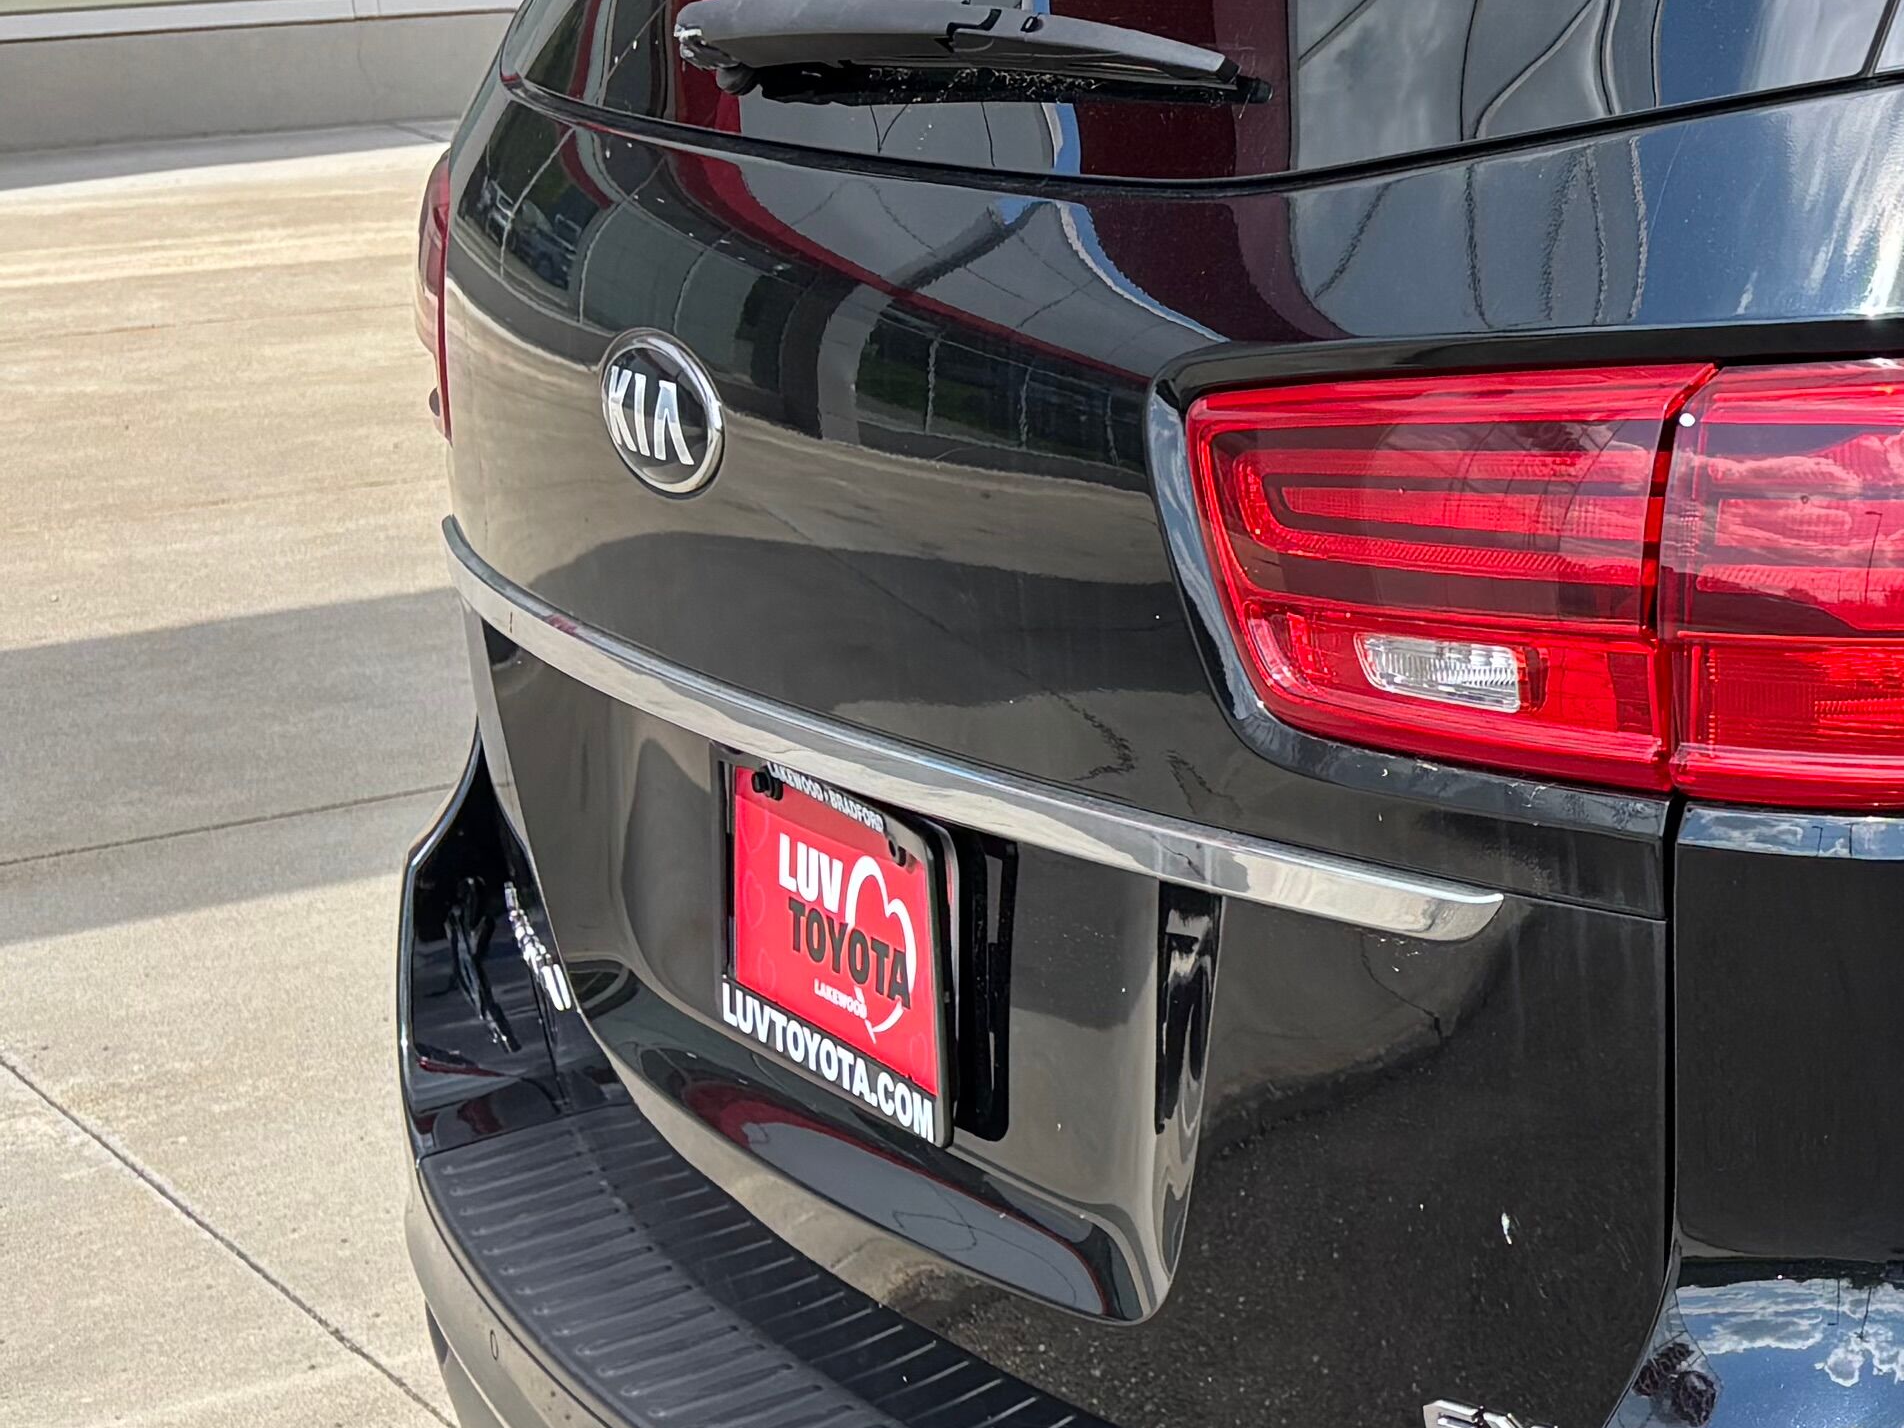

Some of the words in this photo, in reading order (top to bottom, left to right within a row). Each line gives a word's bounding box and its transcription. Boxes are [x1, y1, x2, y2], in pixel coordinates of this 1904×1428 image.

[608, 365, 694, 465] KIA
[766, 761, 824, 802] LAKEWOOD
[829, 788, 884, 833] BRADFORD
[778, 833, 844, 914] LUV
[788, 897, 912, 1010] TOYOTA
[814, 978, 868, 1020] LAKEWOOD
[721, 982, 936, 1144] LUVTOYOTA.COM
